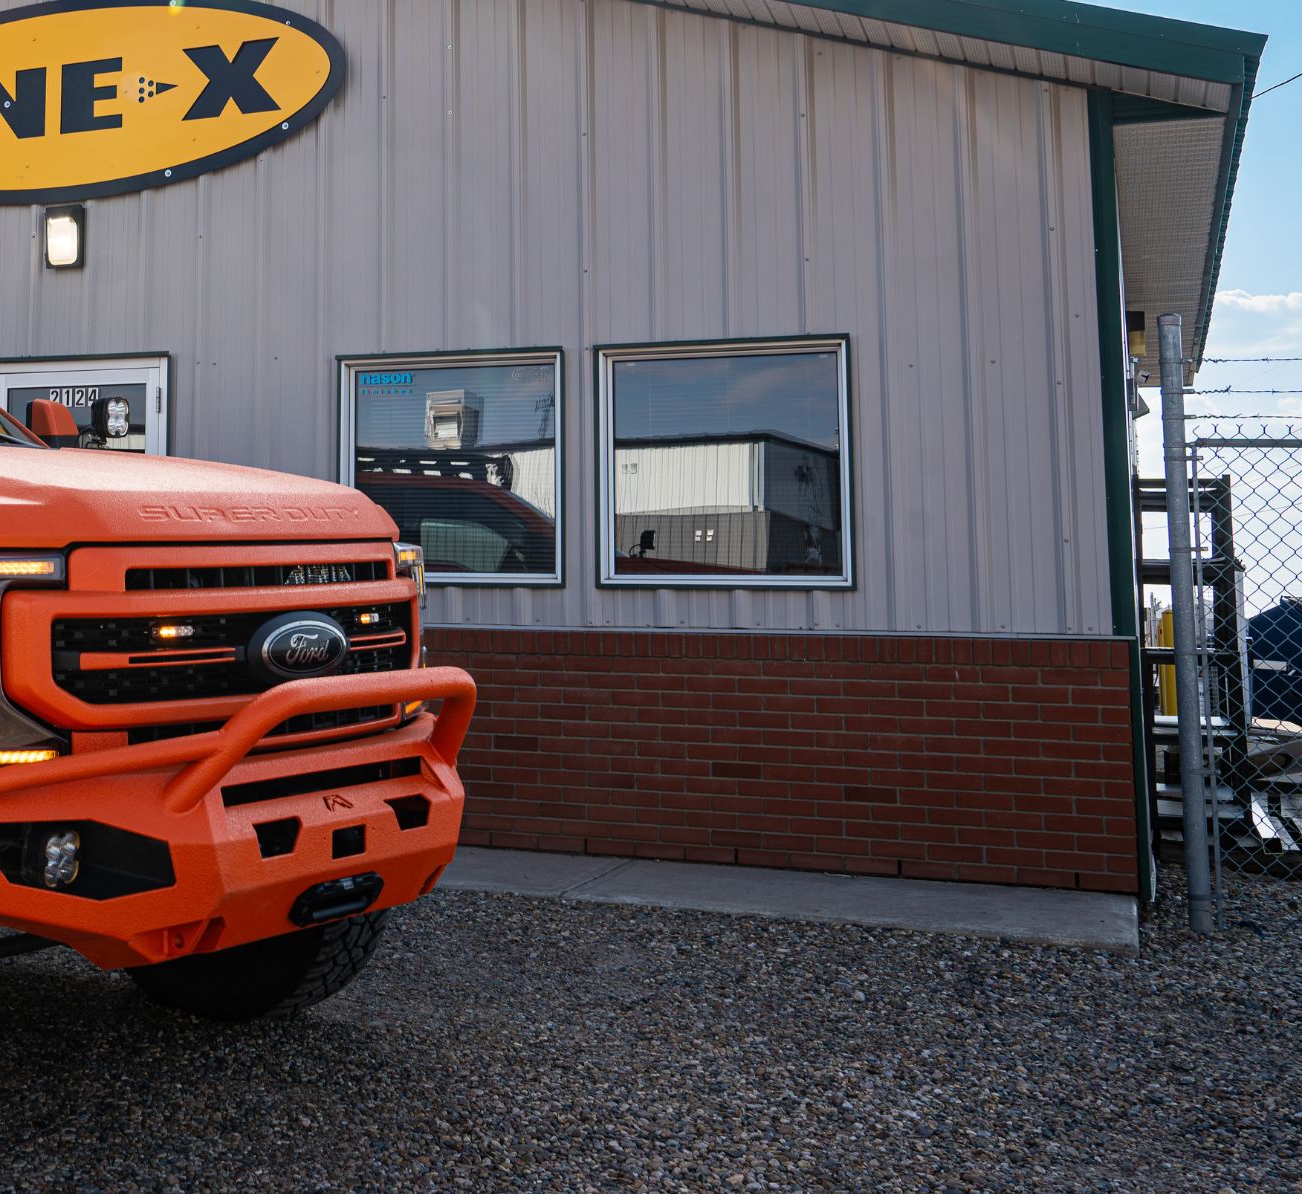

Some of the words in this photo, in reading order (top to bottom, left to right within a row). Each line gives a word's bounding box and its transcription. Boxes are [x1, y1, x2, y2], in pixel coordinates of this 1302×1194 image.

[360, 372, 412, 385] nason
[50, 389, 97, 406] 2124
[137, 505, 282, 523] SUPER
[282, 506, 360, 522] DUTY
[285, 633, 330, 666] Ford
